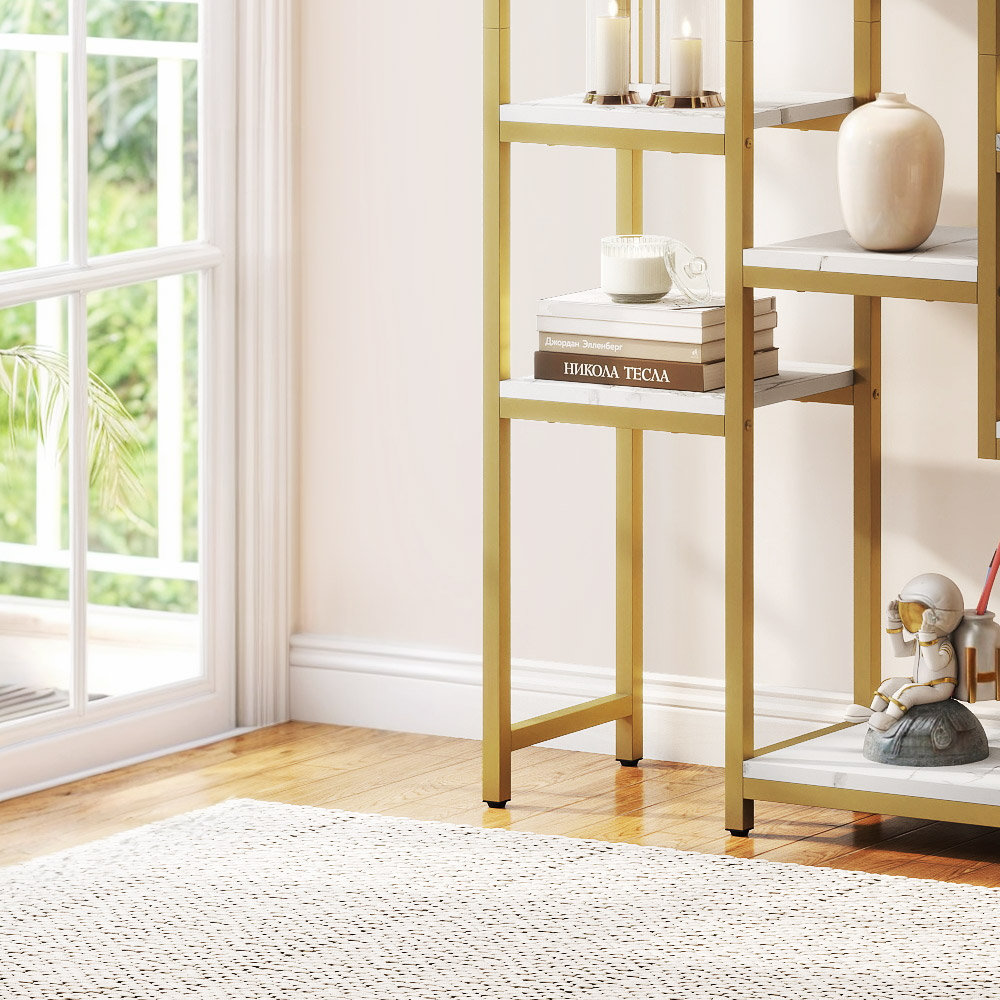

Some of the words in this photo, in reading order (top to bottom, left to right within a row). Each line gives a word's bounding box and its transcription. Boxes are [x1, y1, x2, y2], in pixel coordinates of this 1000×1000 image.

[545, 336, 580, 348] Джордан
[582, 339, 623, 352] Элленберг
[563, 362, 620, 379] НИКОЛА
[623, 365, 671, 383] ТЕСЛА
